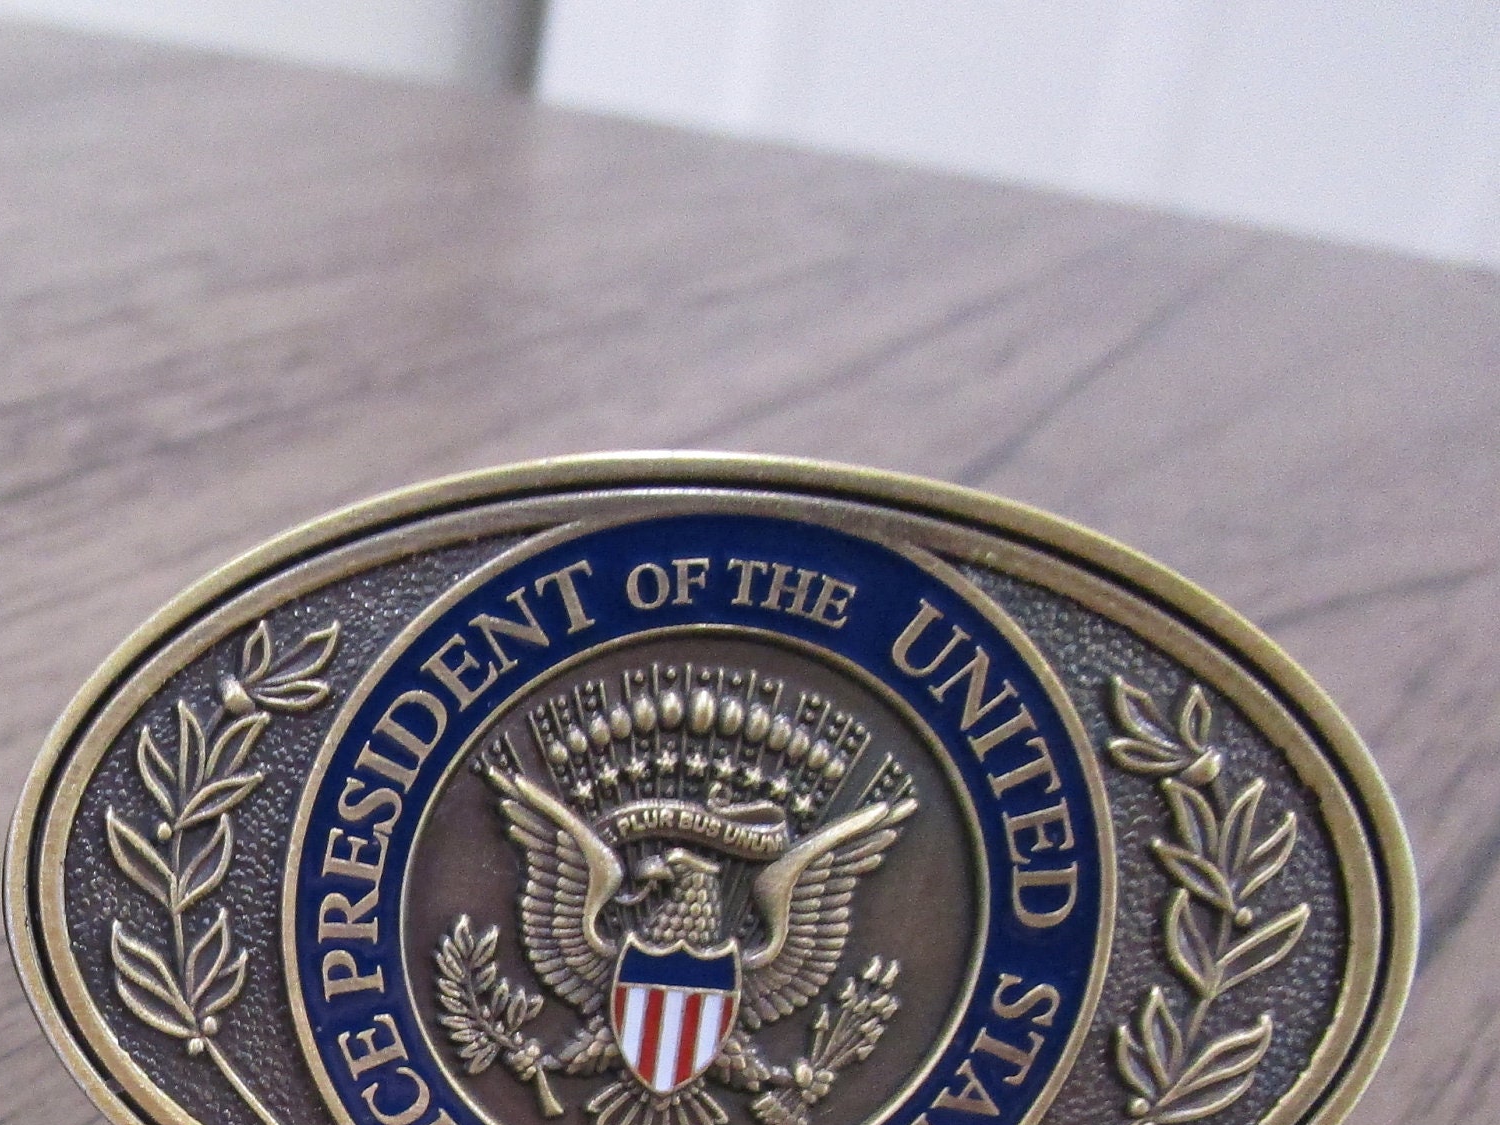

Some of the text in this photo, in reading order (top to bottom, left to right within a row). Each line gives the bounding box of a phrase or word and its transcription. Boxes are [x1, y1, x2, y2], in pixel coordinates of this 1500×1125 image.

[318, 559, 596, 1003] PRESIDENT
[626, 557, 710, 610] OF
[727, 557, 857, 629] THE
[891, 598, 1079, 929] UNITED
